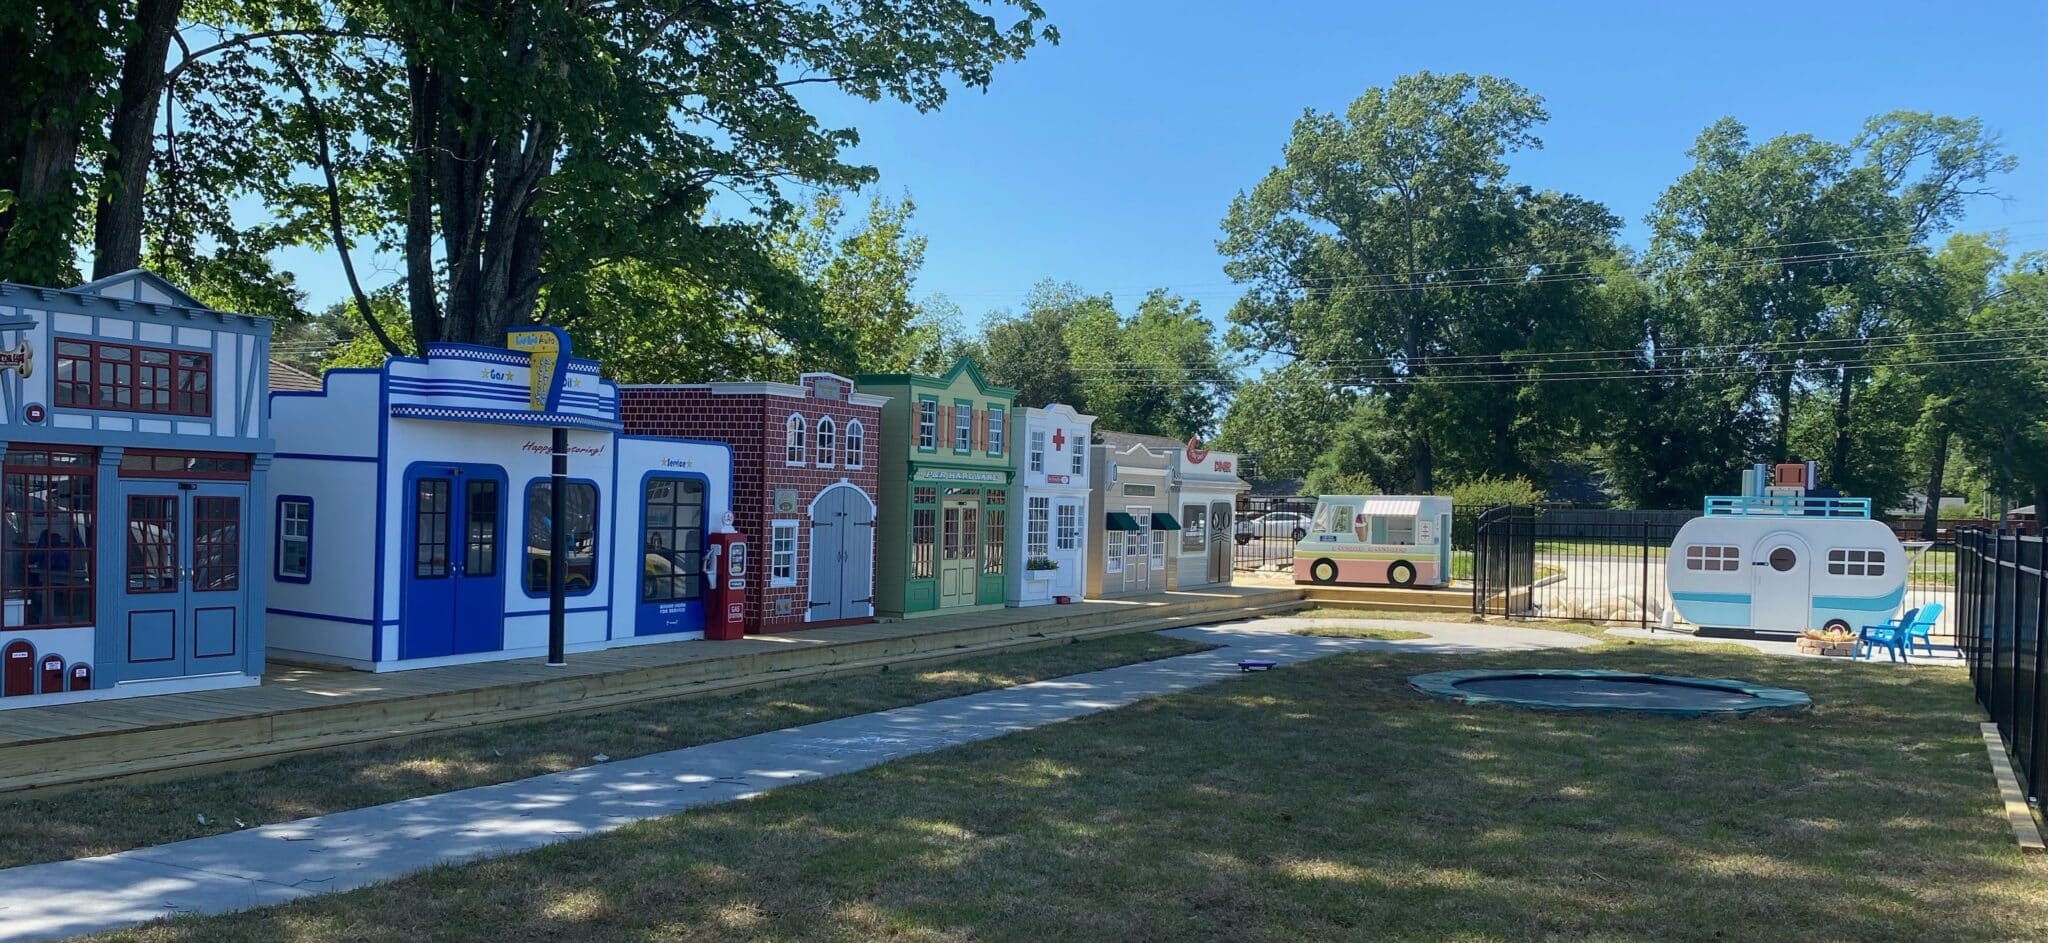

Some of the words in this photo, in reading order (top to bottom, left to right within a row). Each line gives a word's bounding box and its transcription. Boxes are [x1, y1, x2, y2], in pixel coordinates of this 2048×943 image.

[539, 335, 555, 344] Auto
[490, 369, 504, 380] Gas
[948, 472, 998, 481] HARDWARE
[731, 605, 742, 613] GAS
